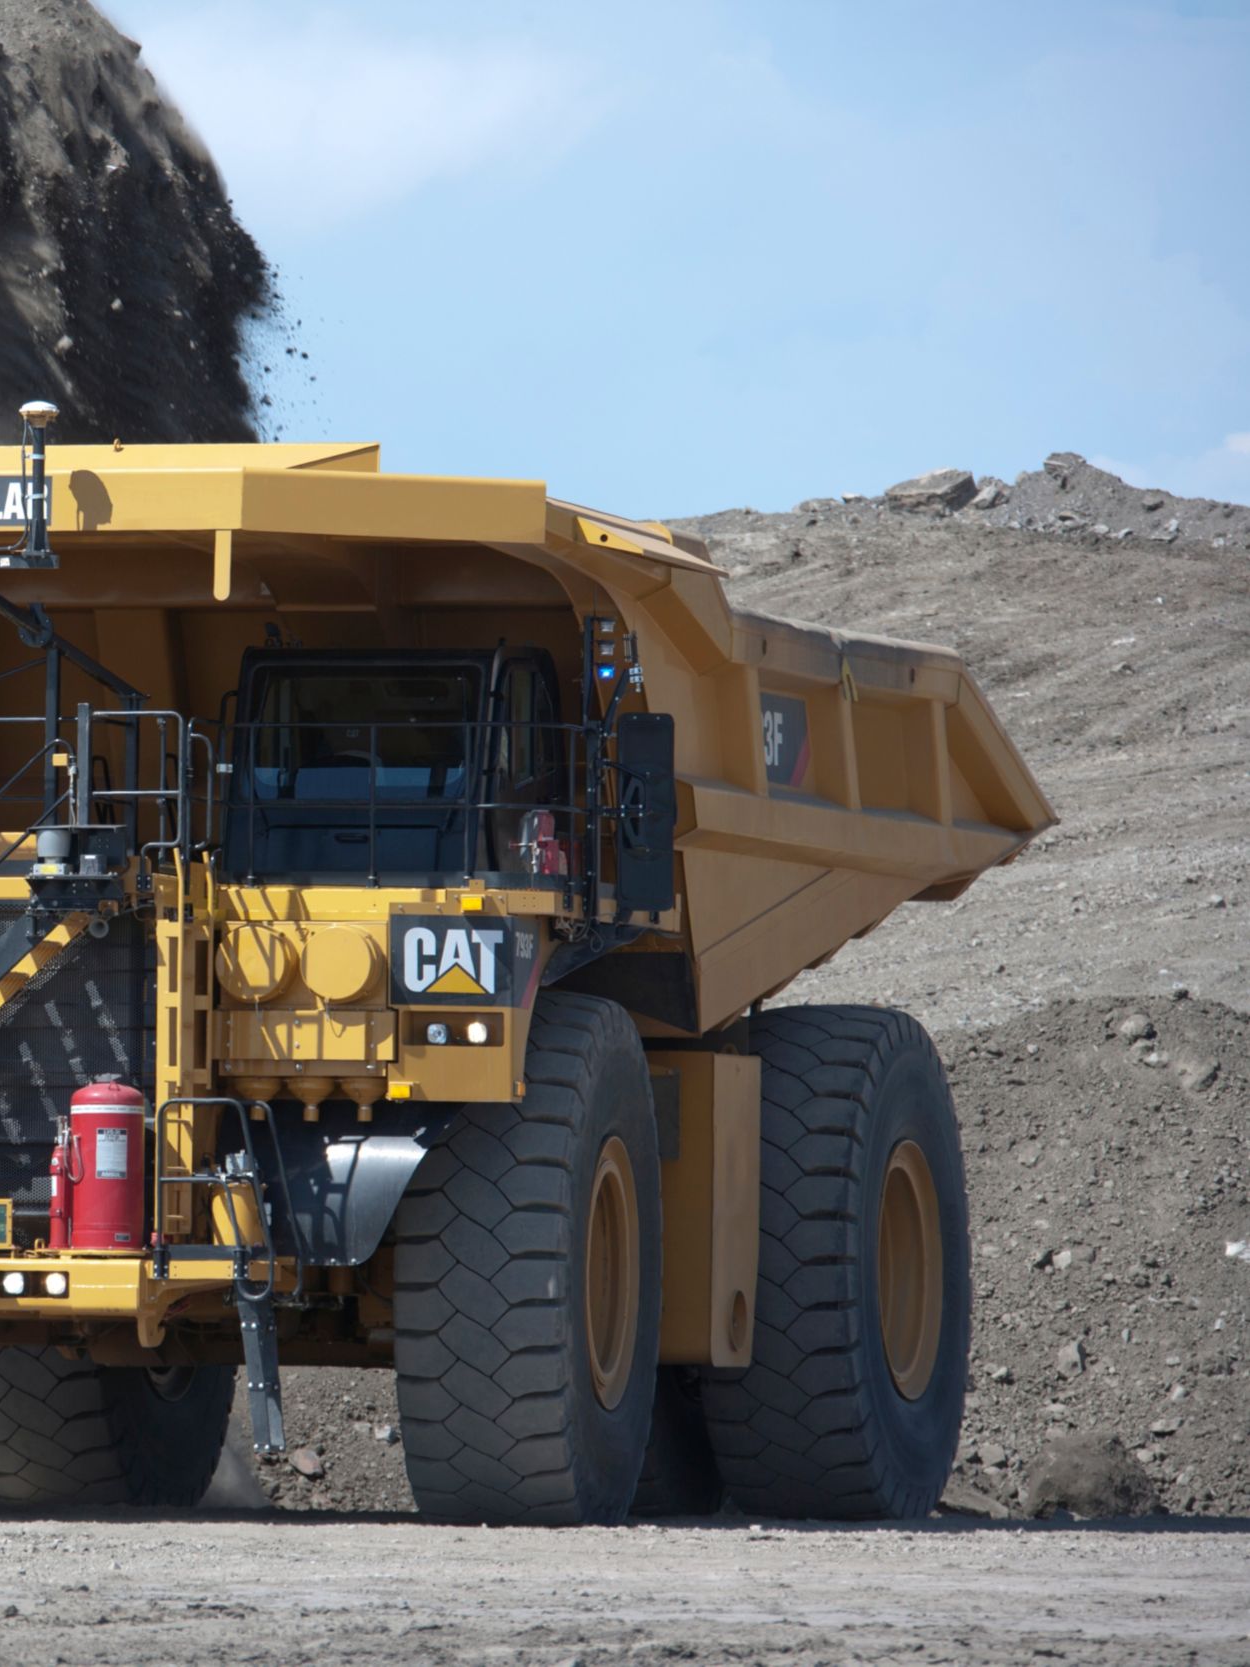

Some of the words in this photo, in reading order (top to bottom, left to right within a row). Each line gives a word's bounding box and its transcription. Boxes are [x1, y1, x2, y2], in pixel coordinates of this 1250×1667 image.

[761, 710, 783, 766] 3F
[403, 927, 503, 994] CAT
[515, 931, 534, 960] 793F
